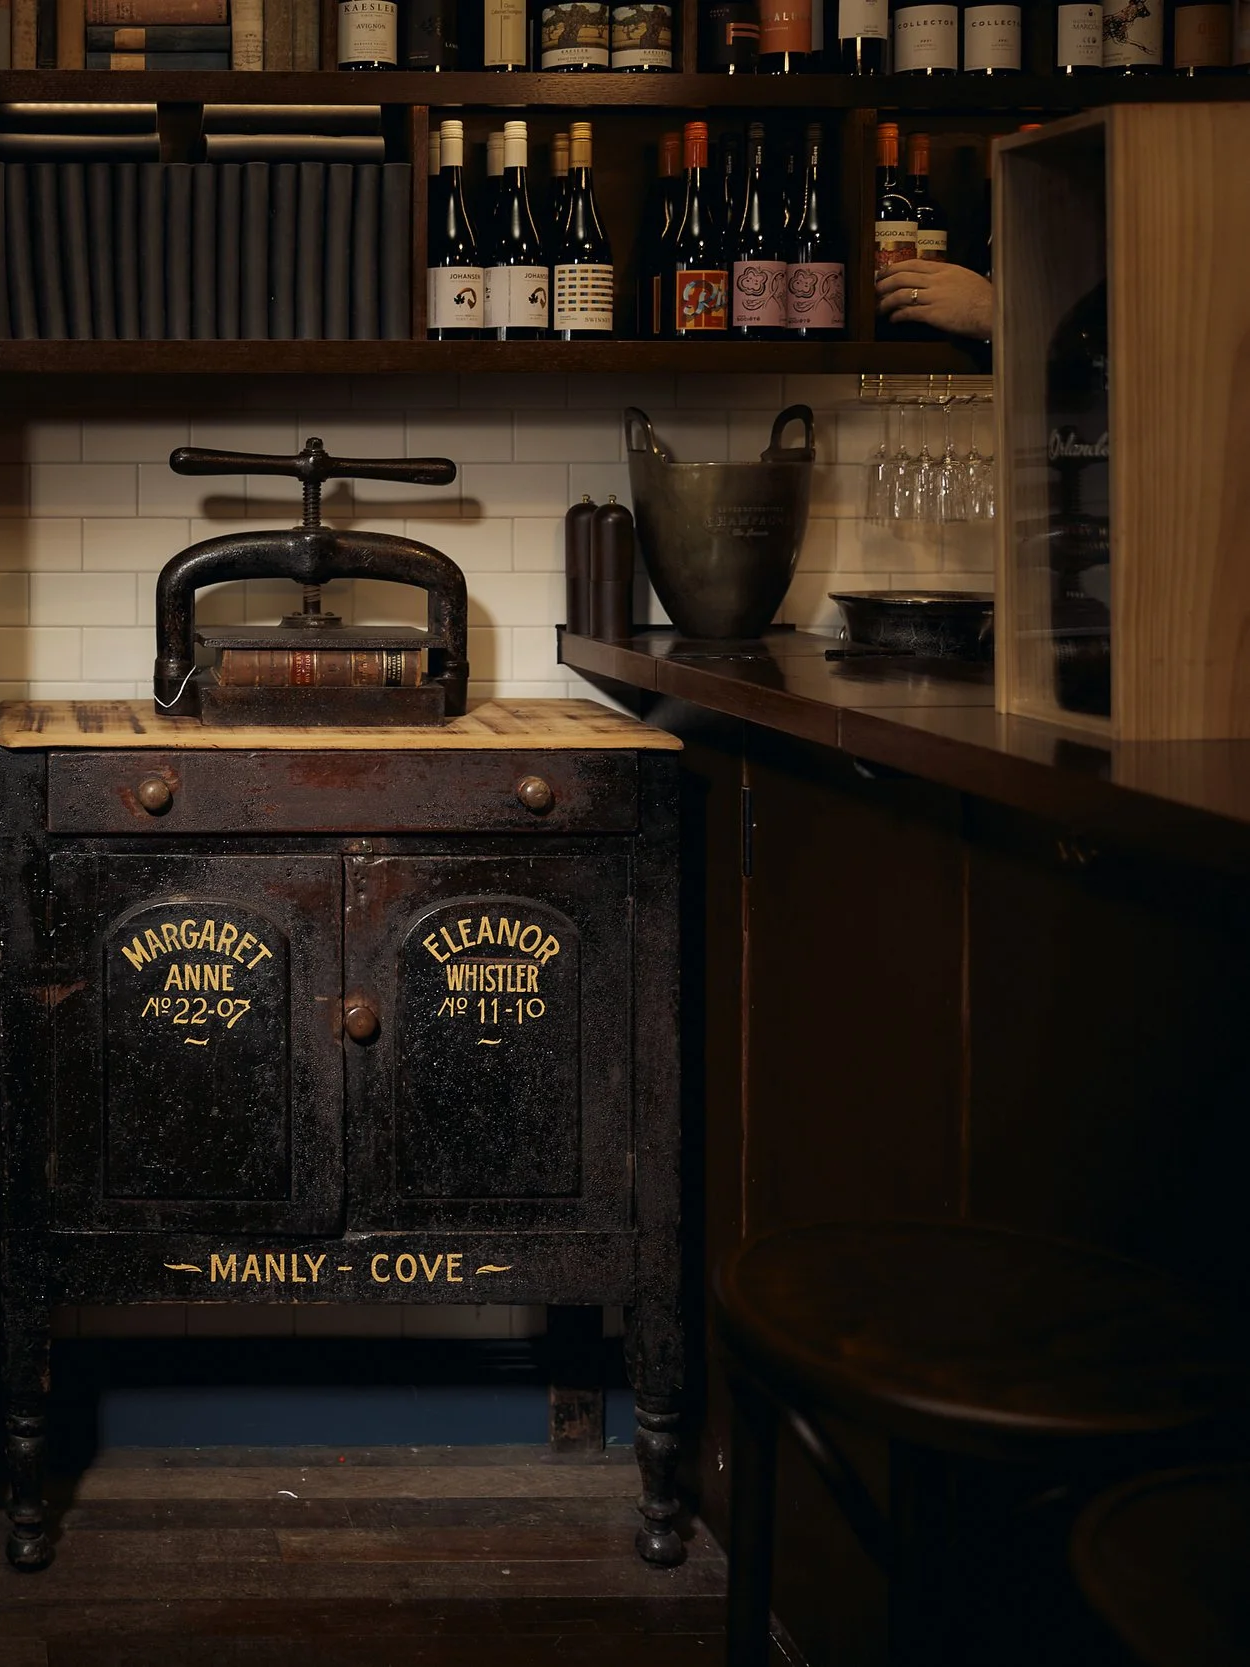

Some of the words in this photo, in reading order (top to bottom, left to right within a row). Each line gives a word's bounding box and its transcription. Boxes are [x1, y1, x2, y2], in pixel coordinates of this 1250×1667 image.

[344, 3, 395, 13] KAESLER
[120, 918, 273, 973] MARGARET
[421, 916, 561, 965] ELEANOR
[163, 963, 235, 992] ANNE
[445, 963, 540, 994] WHISTLER
[172, 997, 252, 1030] 22-07
[476, 997, 547, 1025] 11-10
[210, 1253, 327, 1283] MANLY
[370, 1253, 464, 1283] COVE
